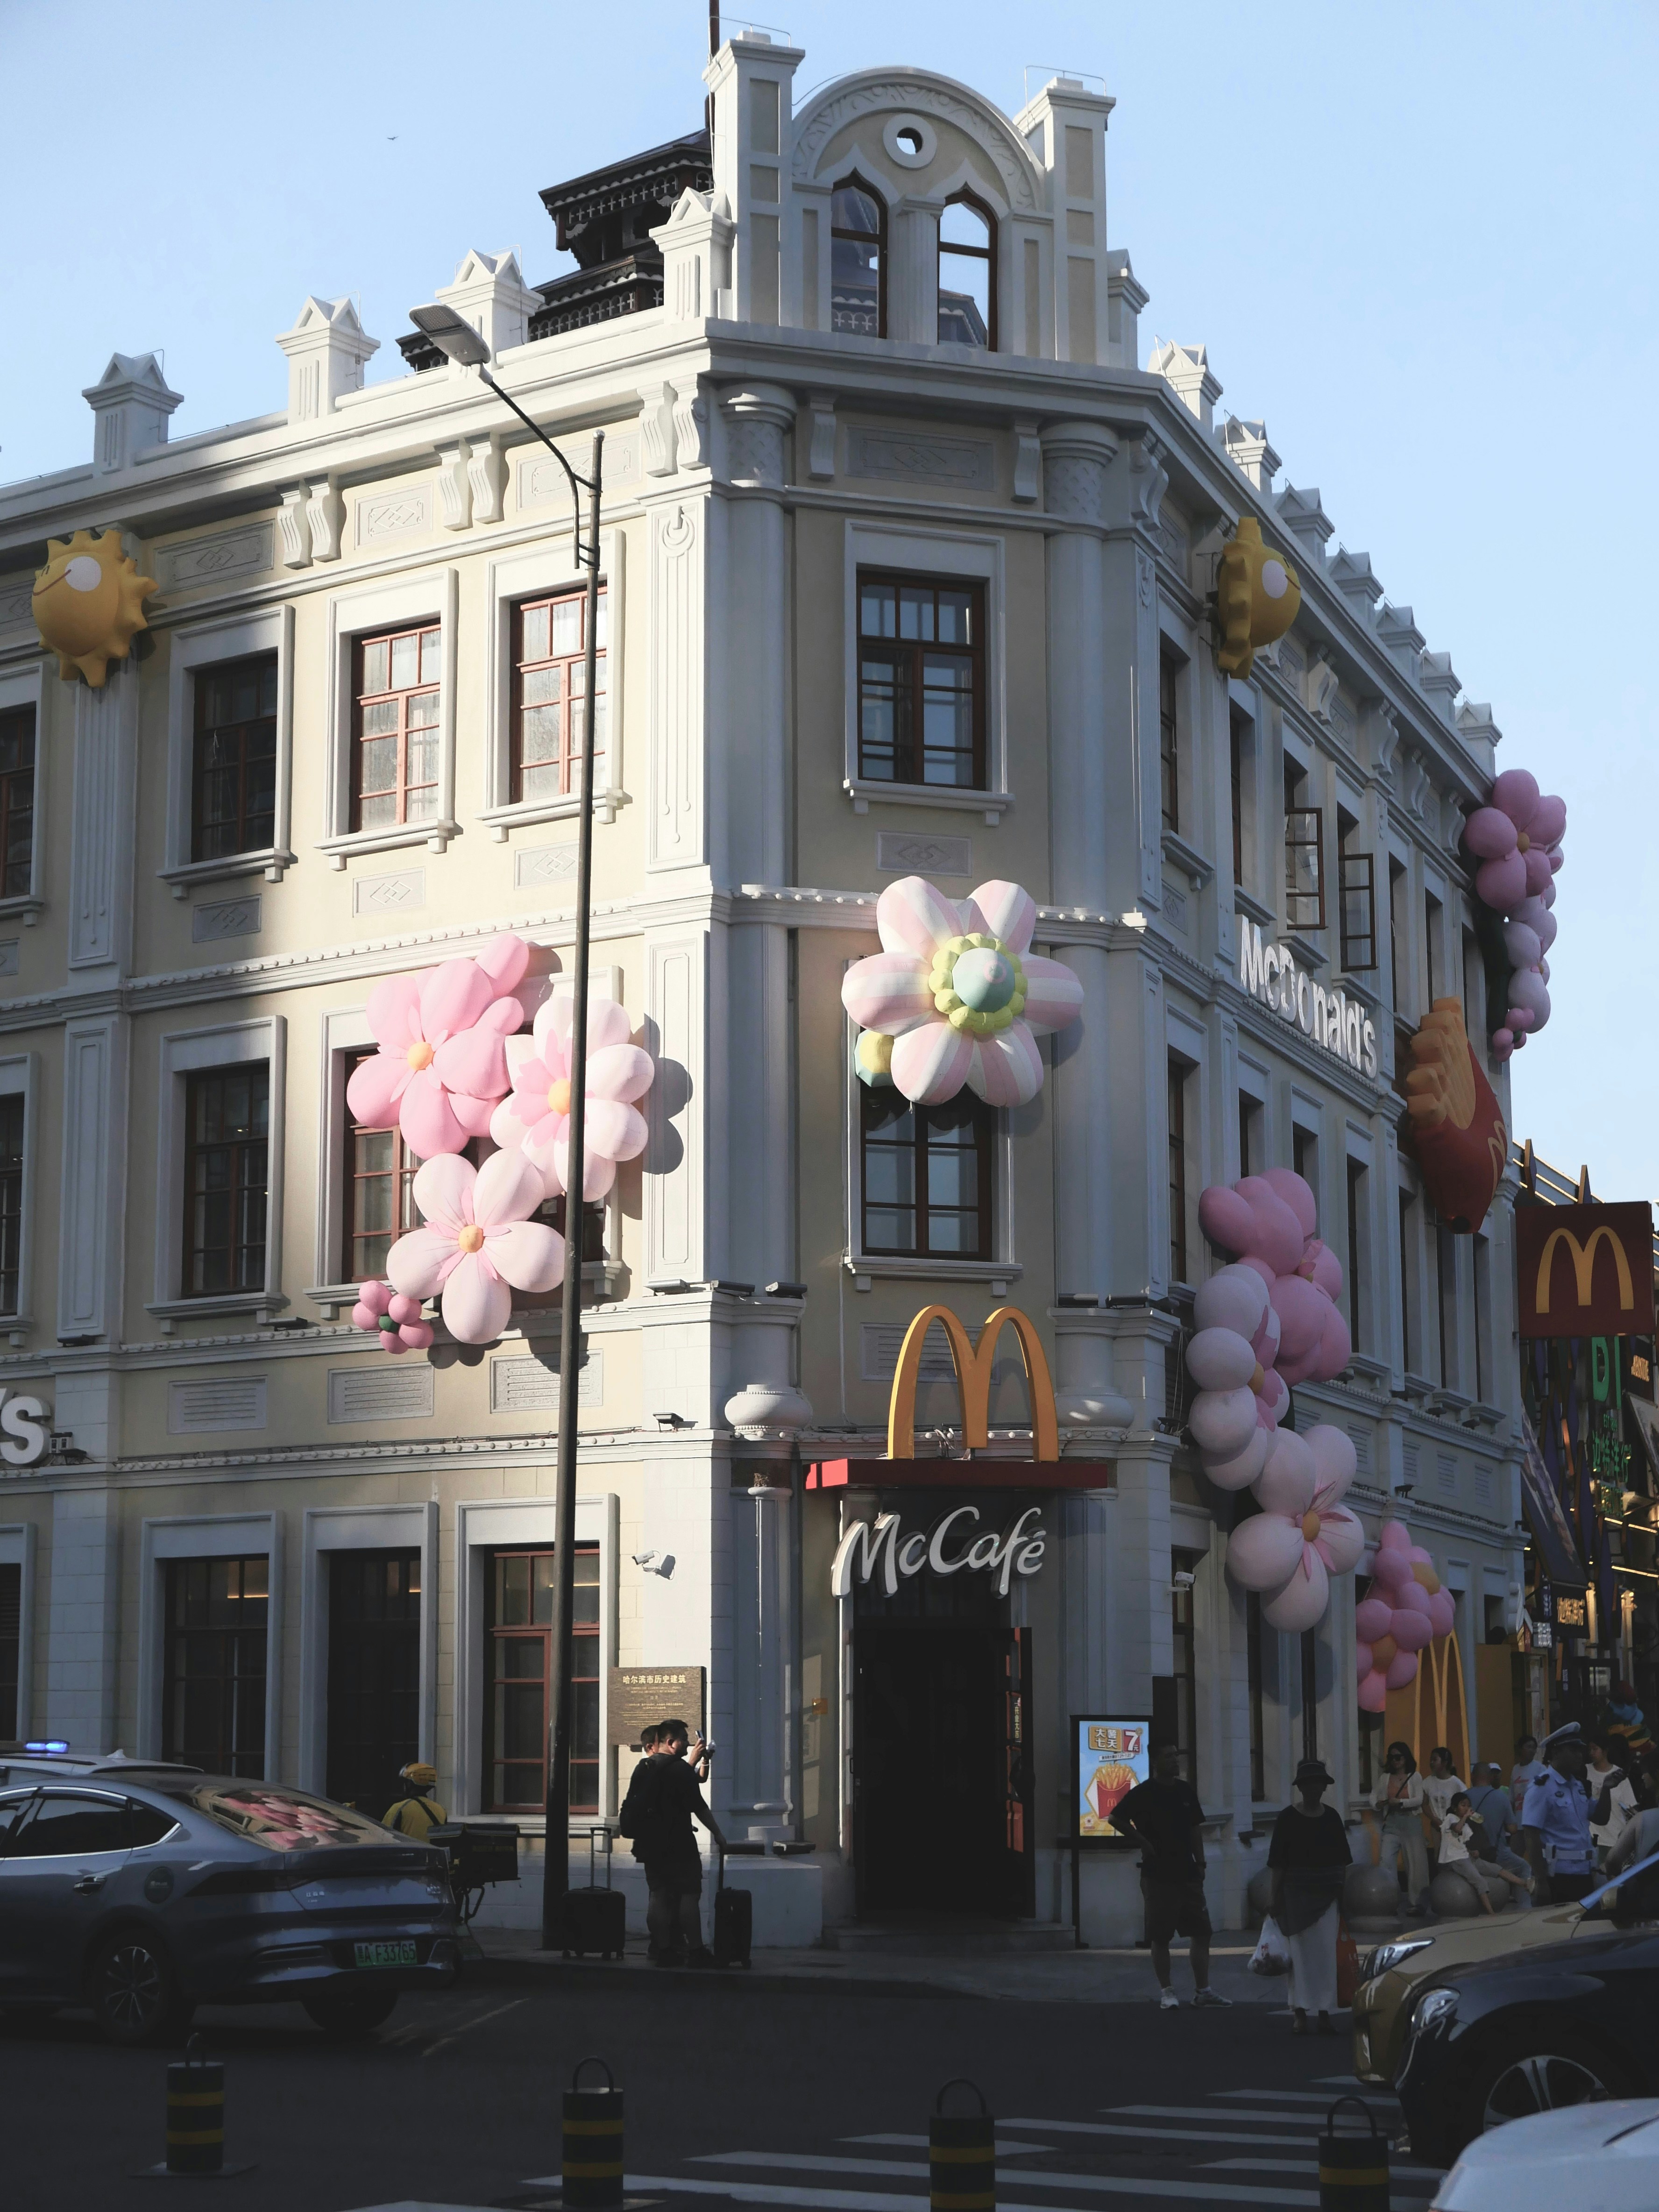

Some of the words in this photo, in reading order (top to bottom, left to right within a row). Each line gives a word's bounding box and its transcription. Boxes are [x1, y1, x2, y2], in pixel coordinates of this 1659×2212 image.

[1240, 914, 1377, 1078] McDonald's
[832, 1505, 1045, 1598] McCafé
[623, 1675, 686, 1684] 哈尔滨市历史建筑
[1095, 1728, 1117, 1739] 大薯
[1095, 1738, 1117, 1749] 七天
